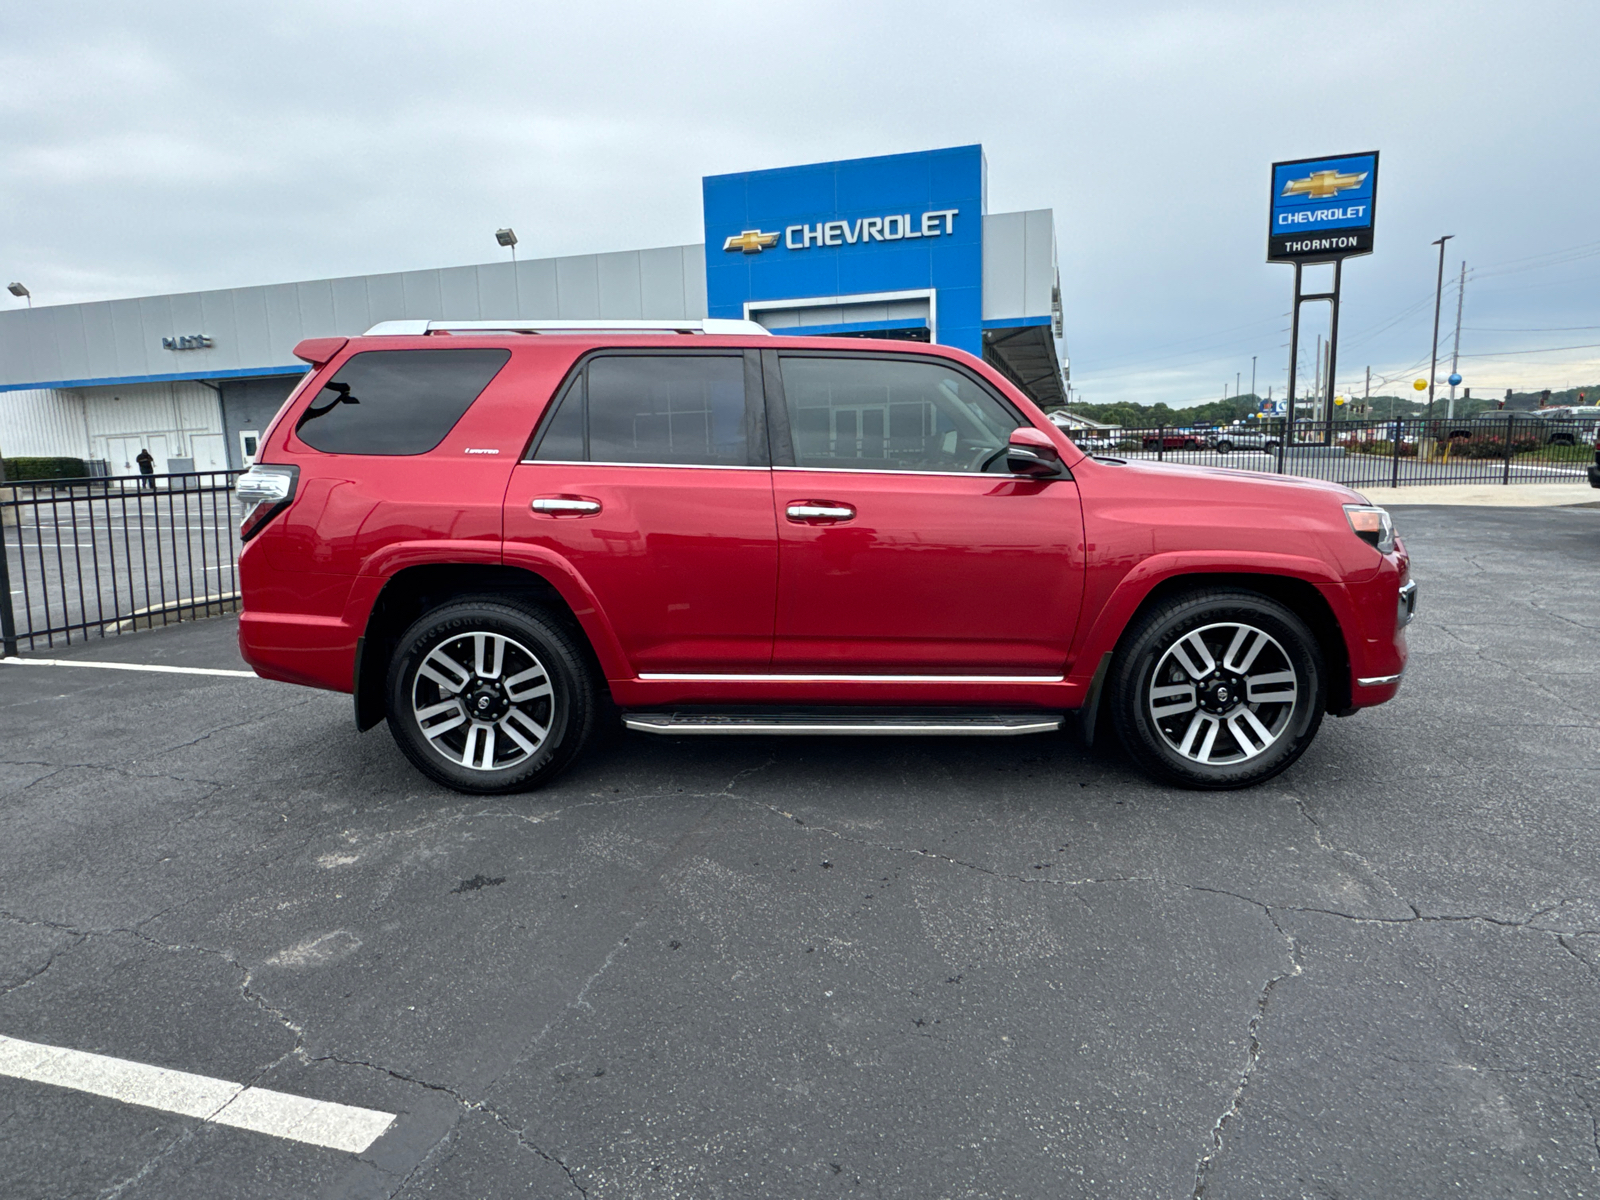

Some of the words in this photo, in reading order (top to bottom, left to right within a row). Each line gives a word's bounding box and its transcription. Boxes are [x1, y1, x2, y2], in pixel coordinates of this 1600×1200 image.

[1278, 206, 1366, 225] CHEVROLET
[785, 209, 959, 250] CHEVROLET
[1285, 236, 1358, 252] THORNTON
[162, 334, 211, 350] PARTS
